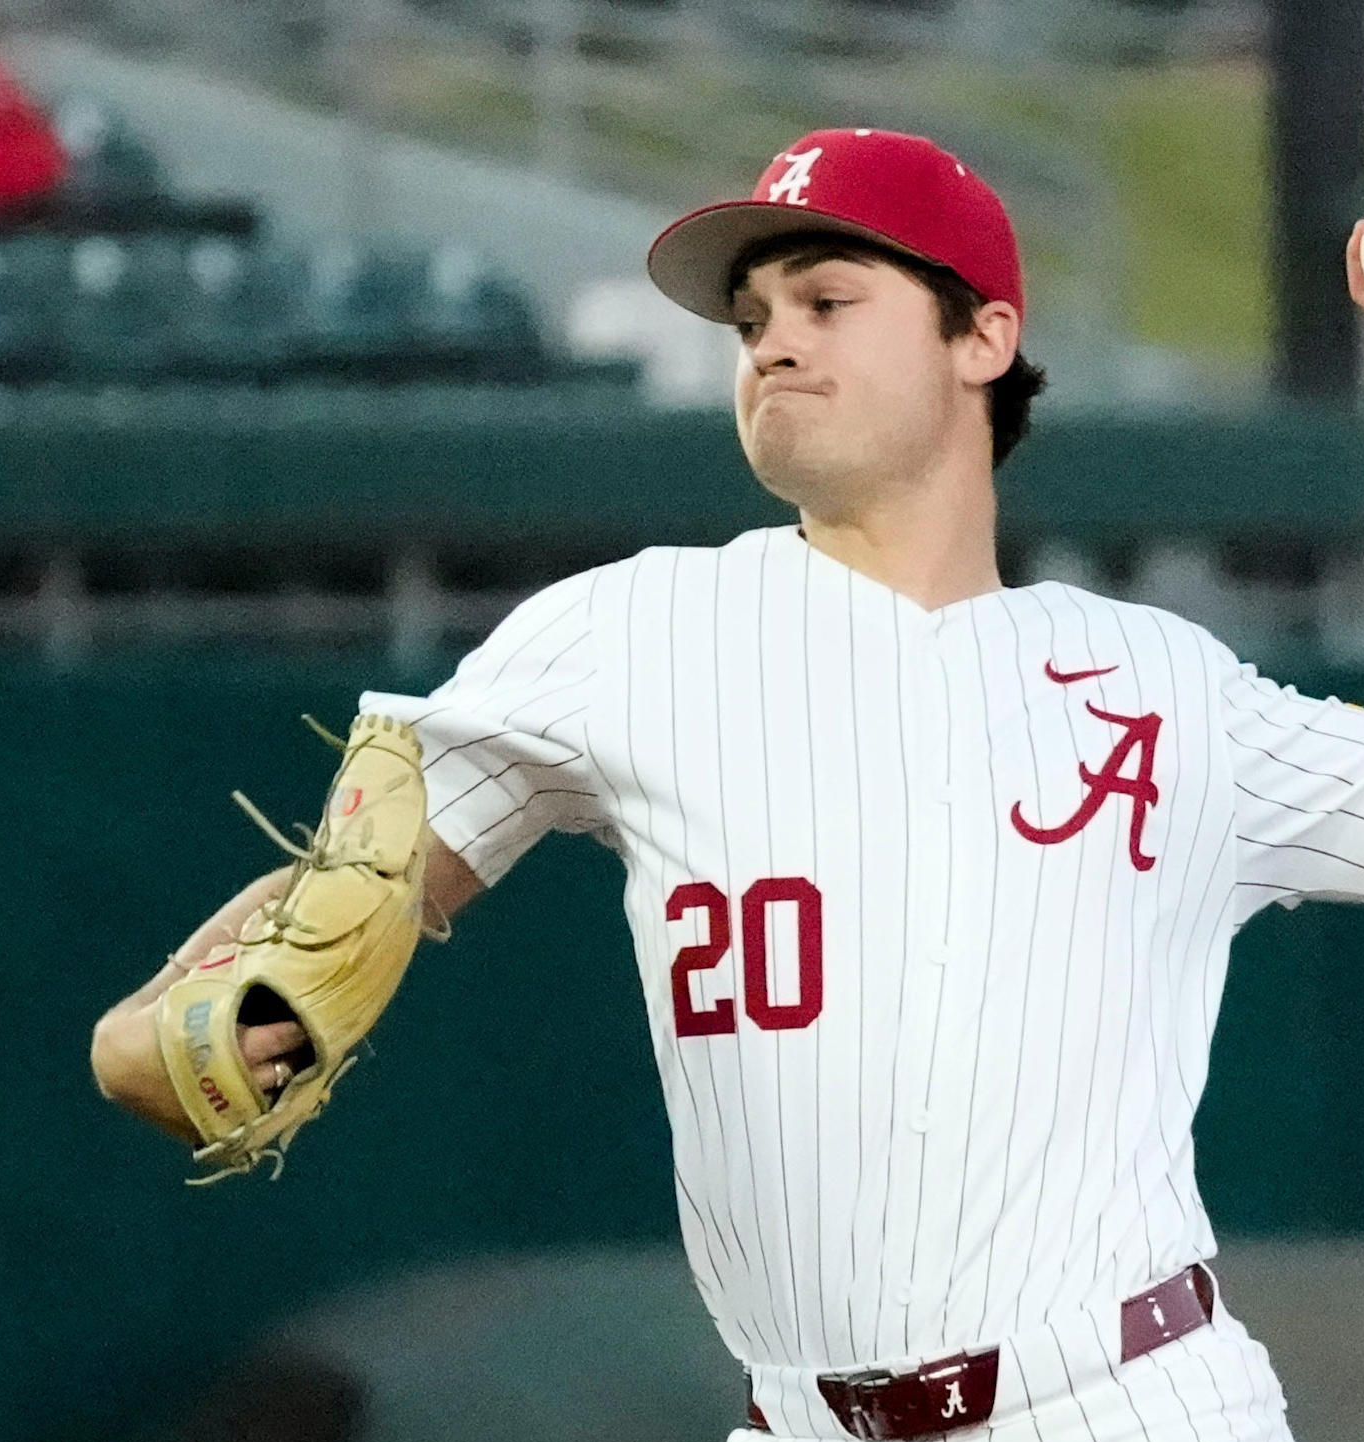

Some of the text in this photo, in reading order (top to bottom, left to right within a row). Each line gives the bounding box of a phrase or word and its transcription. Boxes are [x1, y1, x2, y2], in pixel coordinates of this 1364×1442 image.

[767, 146, 823, 206] A
[1011, 700, 1163, 872] A
[666, 876, 823, 1038] 20
[941, 1380, 968, 1419] A
